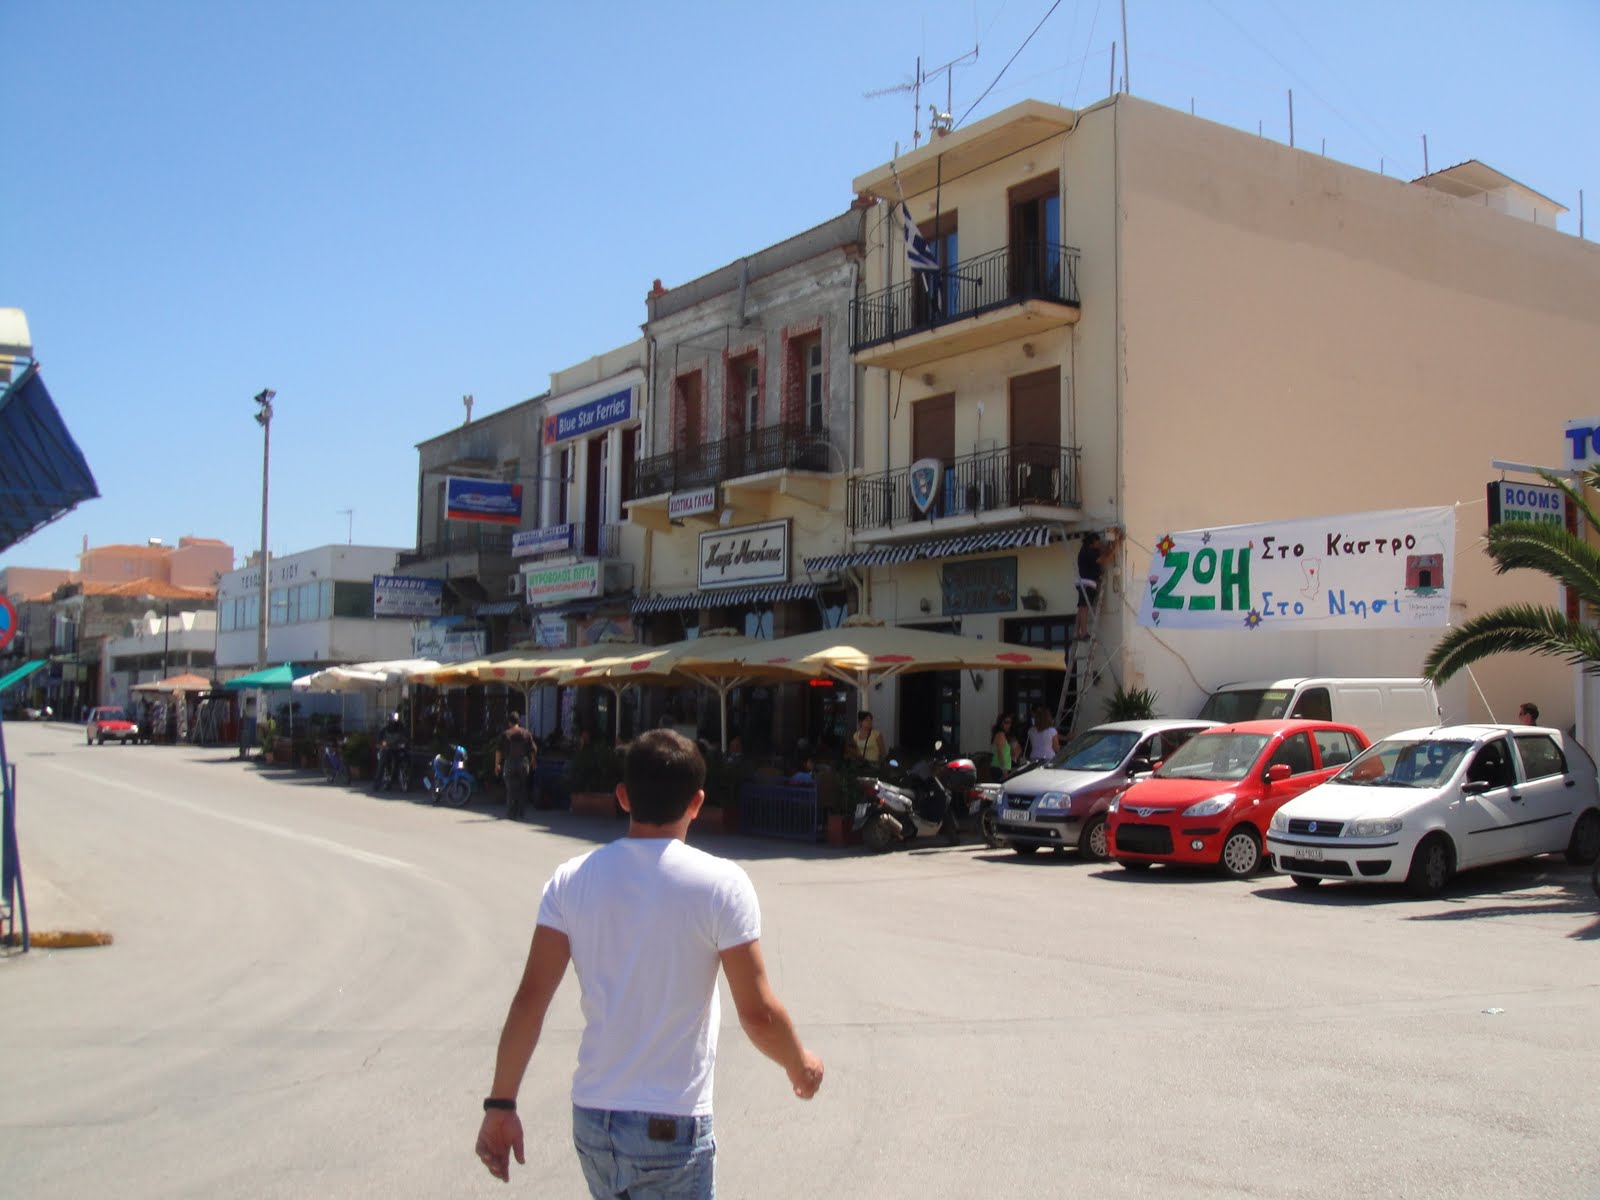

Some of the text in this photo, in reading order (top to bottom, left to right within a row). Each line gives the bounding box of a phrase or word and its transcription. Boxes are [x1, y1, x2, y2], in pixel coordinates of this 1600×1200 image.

[559, 399, 625, 434] Blue Star Ferries
[1505, 488, 1560, 510] ROOMS
[1261, 533, 1416, 560] Στο Κάστρο
[1261, 589, 1401, 619] Στο Νησί
